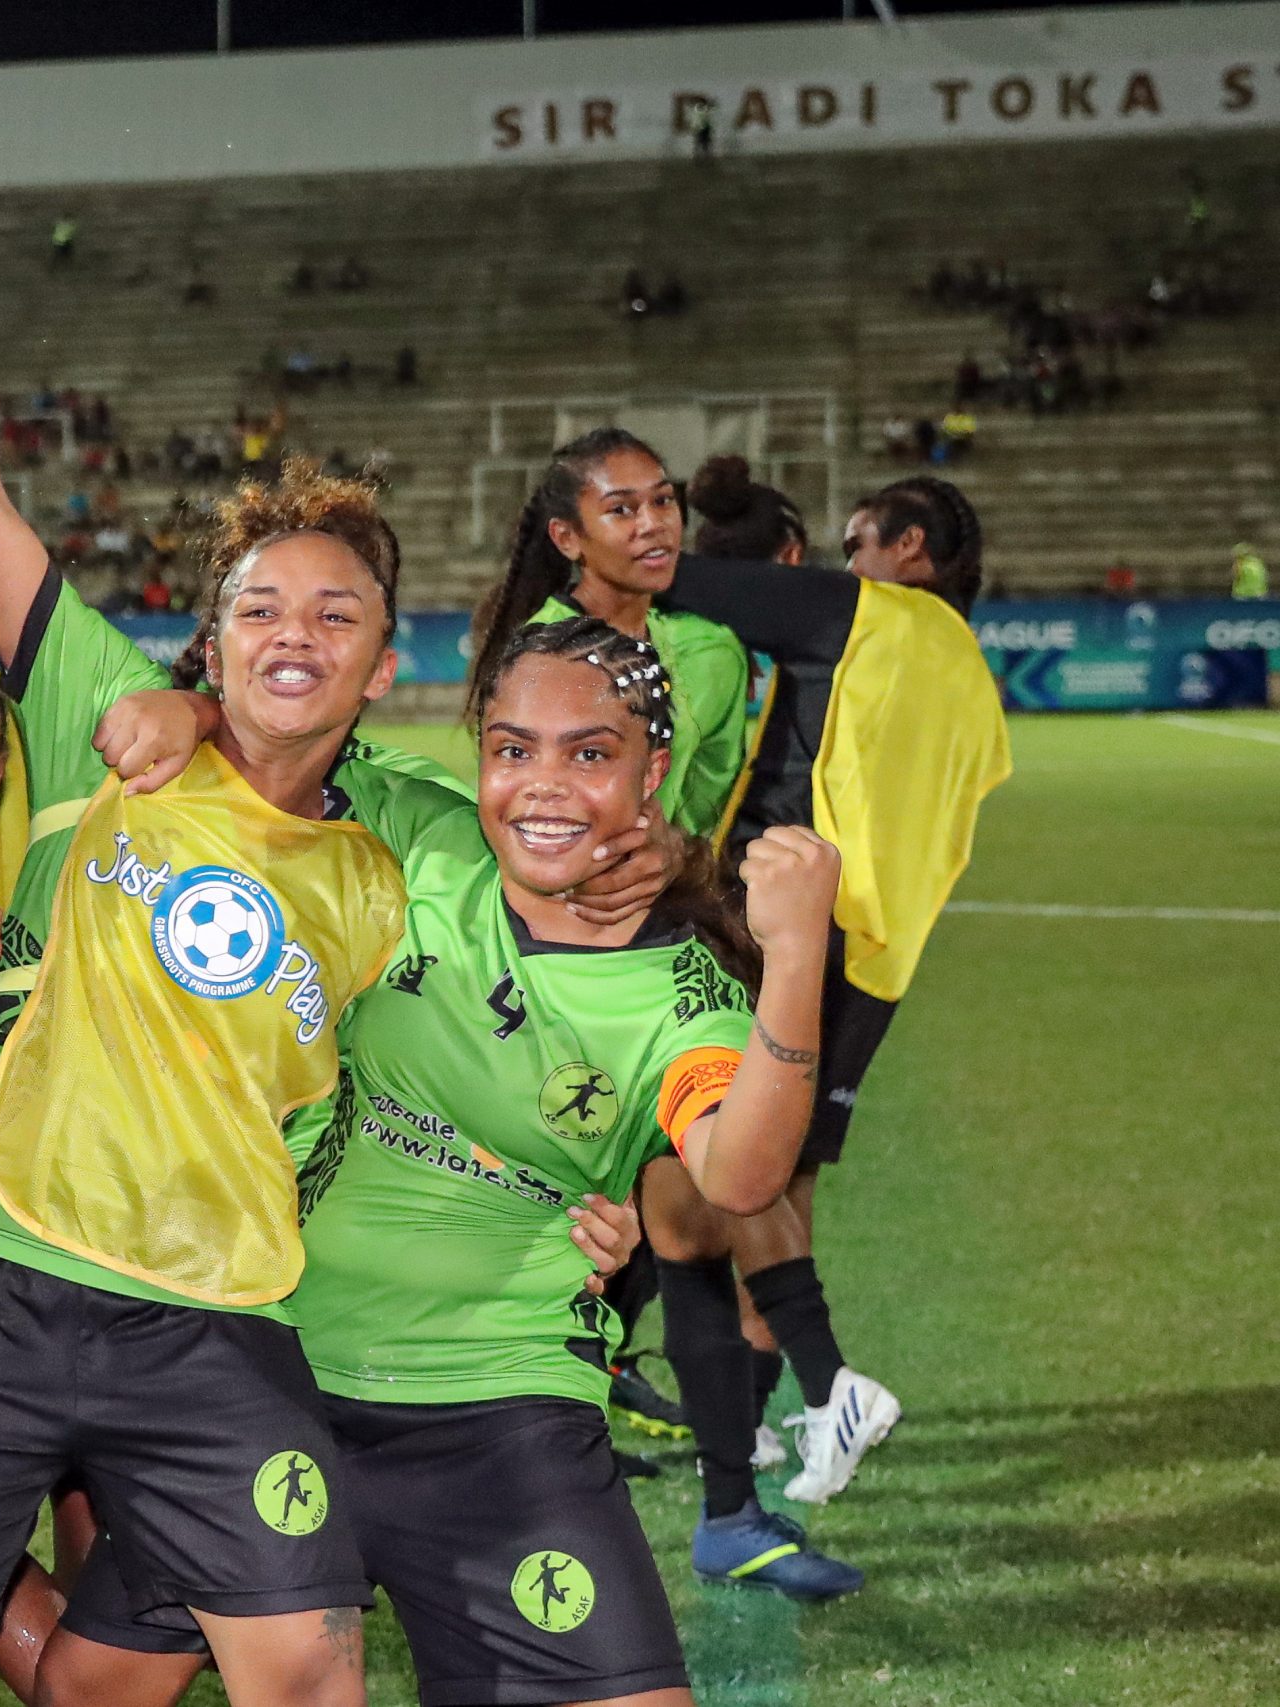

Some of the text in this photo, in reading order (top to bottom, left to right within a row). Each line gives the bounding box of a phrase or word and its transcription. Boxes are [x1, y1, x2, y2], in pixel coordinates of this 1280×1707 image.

[493, 97, 617, 149] SIR
[672, 81, 877, 136] DADI
[930, 71, 1162, 124] TOKA
[228, 872, 262, 896] OFC
[153, 916, 257, 996] GRASSROOTS PROGRAMME
[265, 940, 329, 1044] Play
[577, 1126, 603, 1140] ASAF
[311, 1502, 326, 1528] ASAF
[571, 1595, 591, 1623] ASAF
